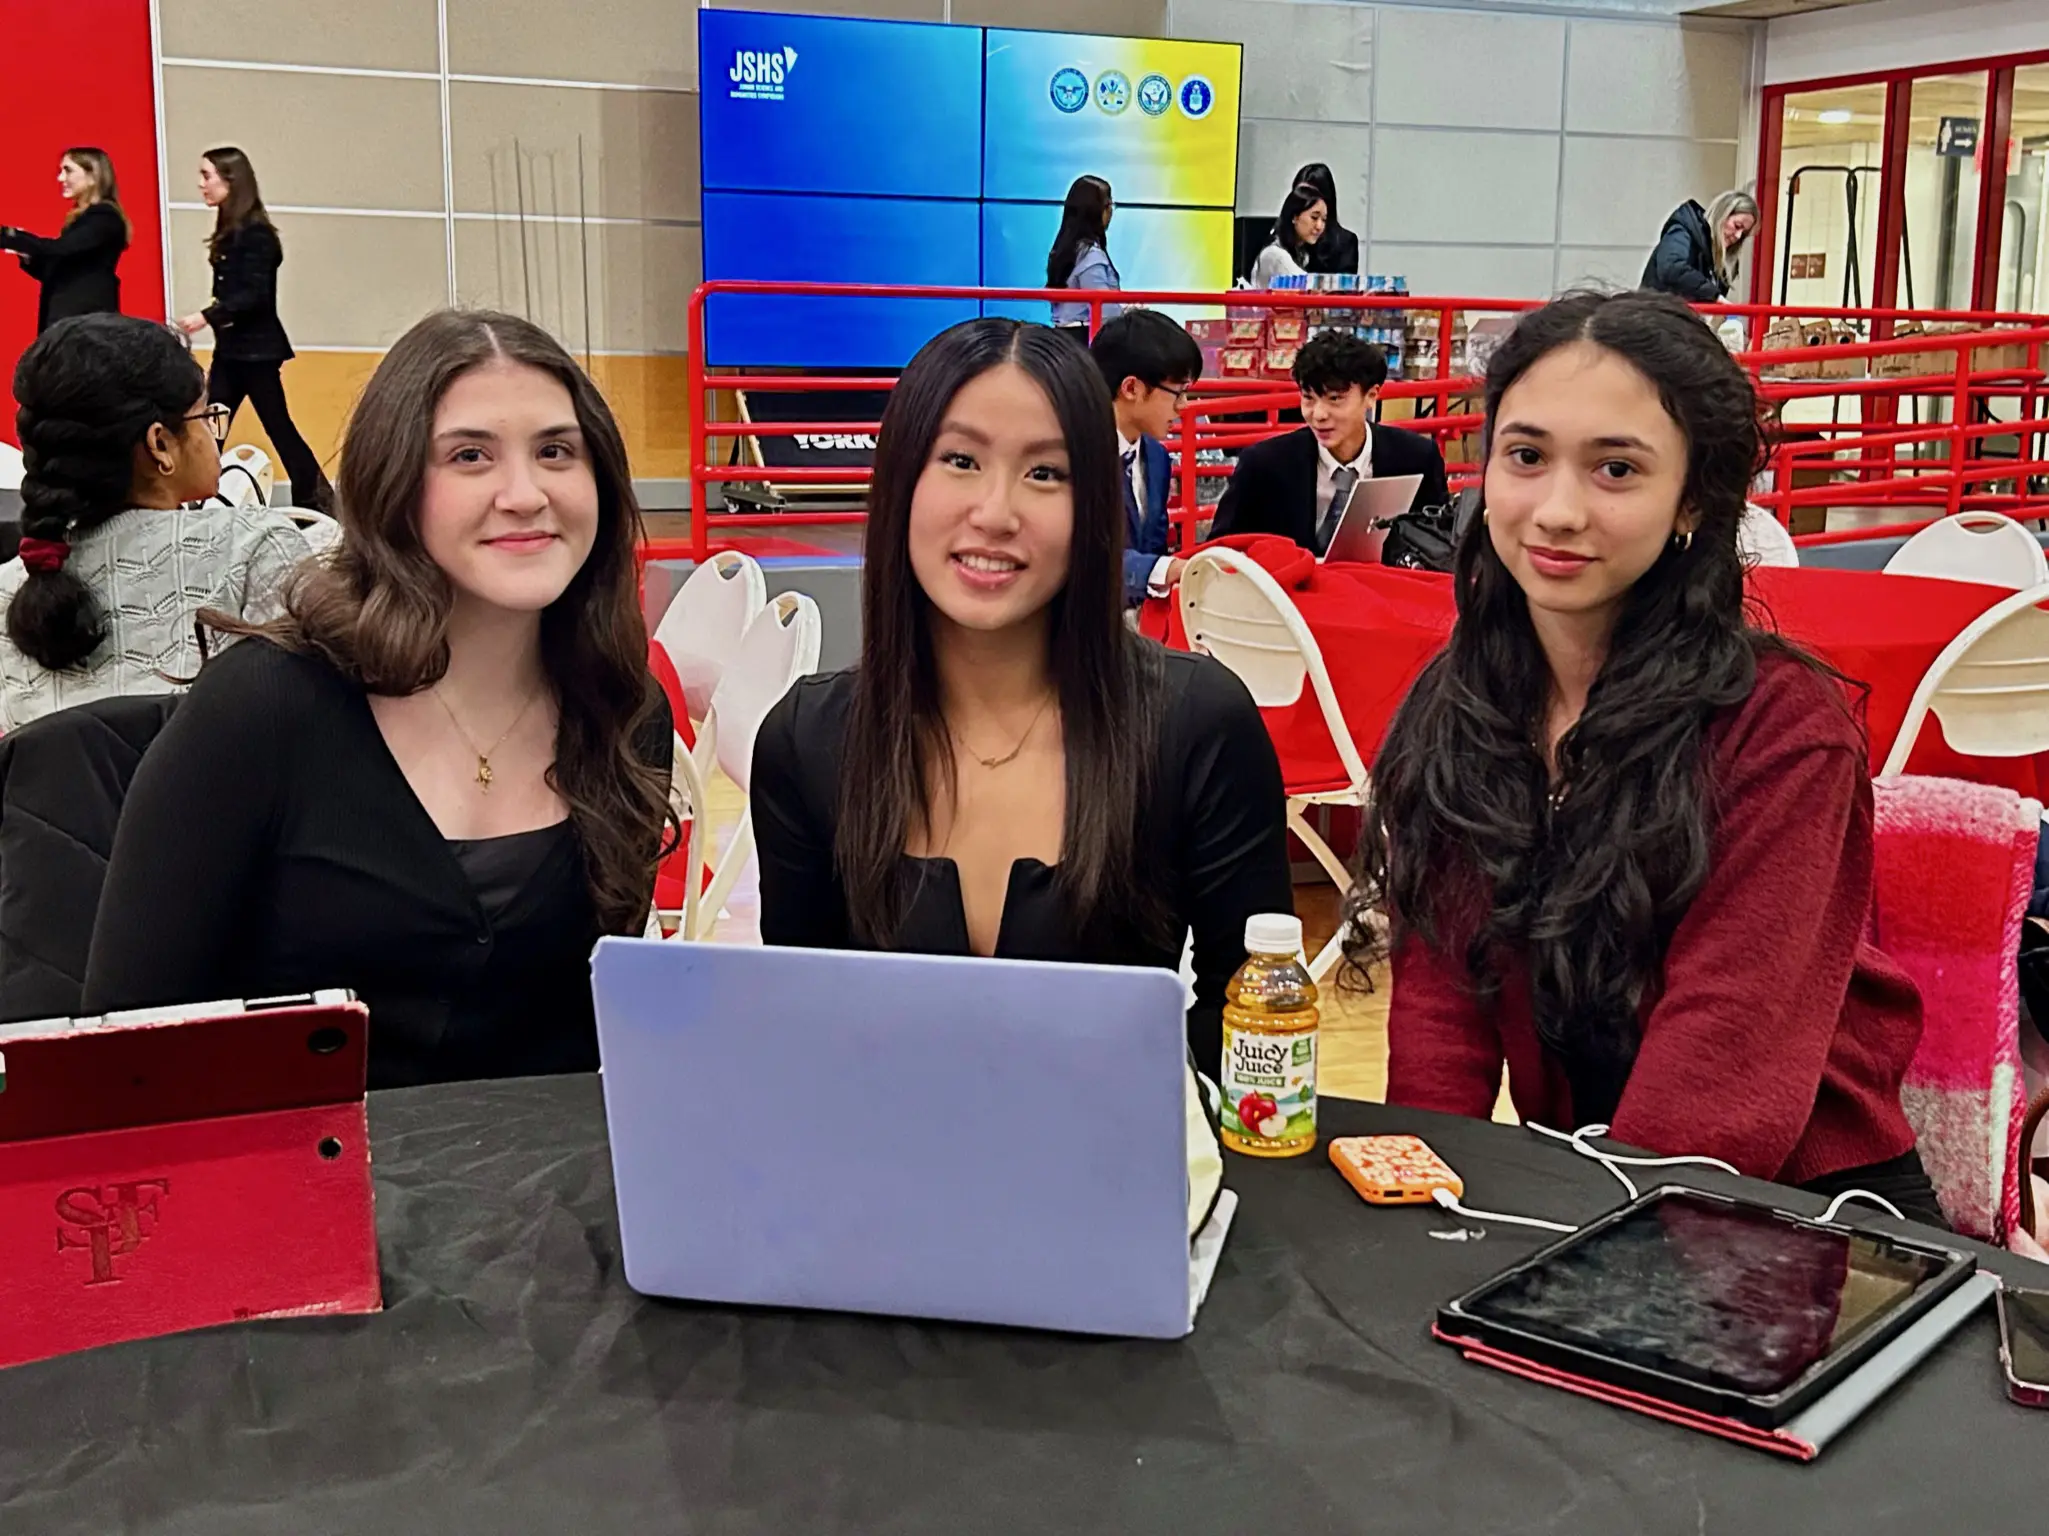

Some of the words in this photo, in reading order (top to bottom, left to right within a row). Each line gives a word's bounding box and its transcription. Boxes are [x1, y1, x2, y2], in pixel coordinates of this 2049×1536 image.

[729, 50, 785, 84] JSHS
[1233, 1038, 1289, 1063] Juicy
[1235, 1057, 1283, 1074] Juice
